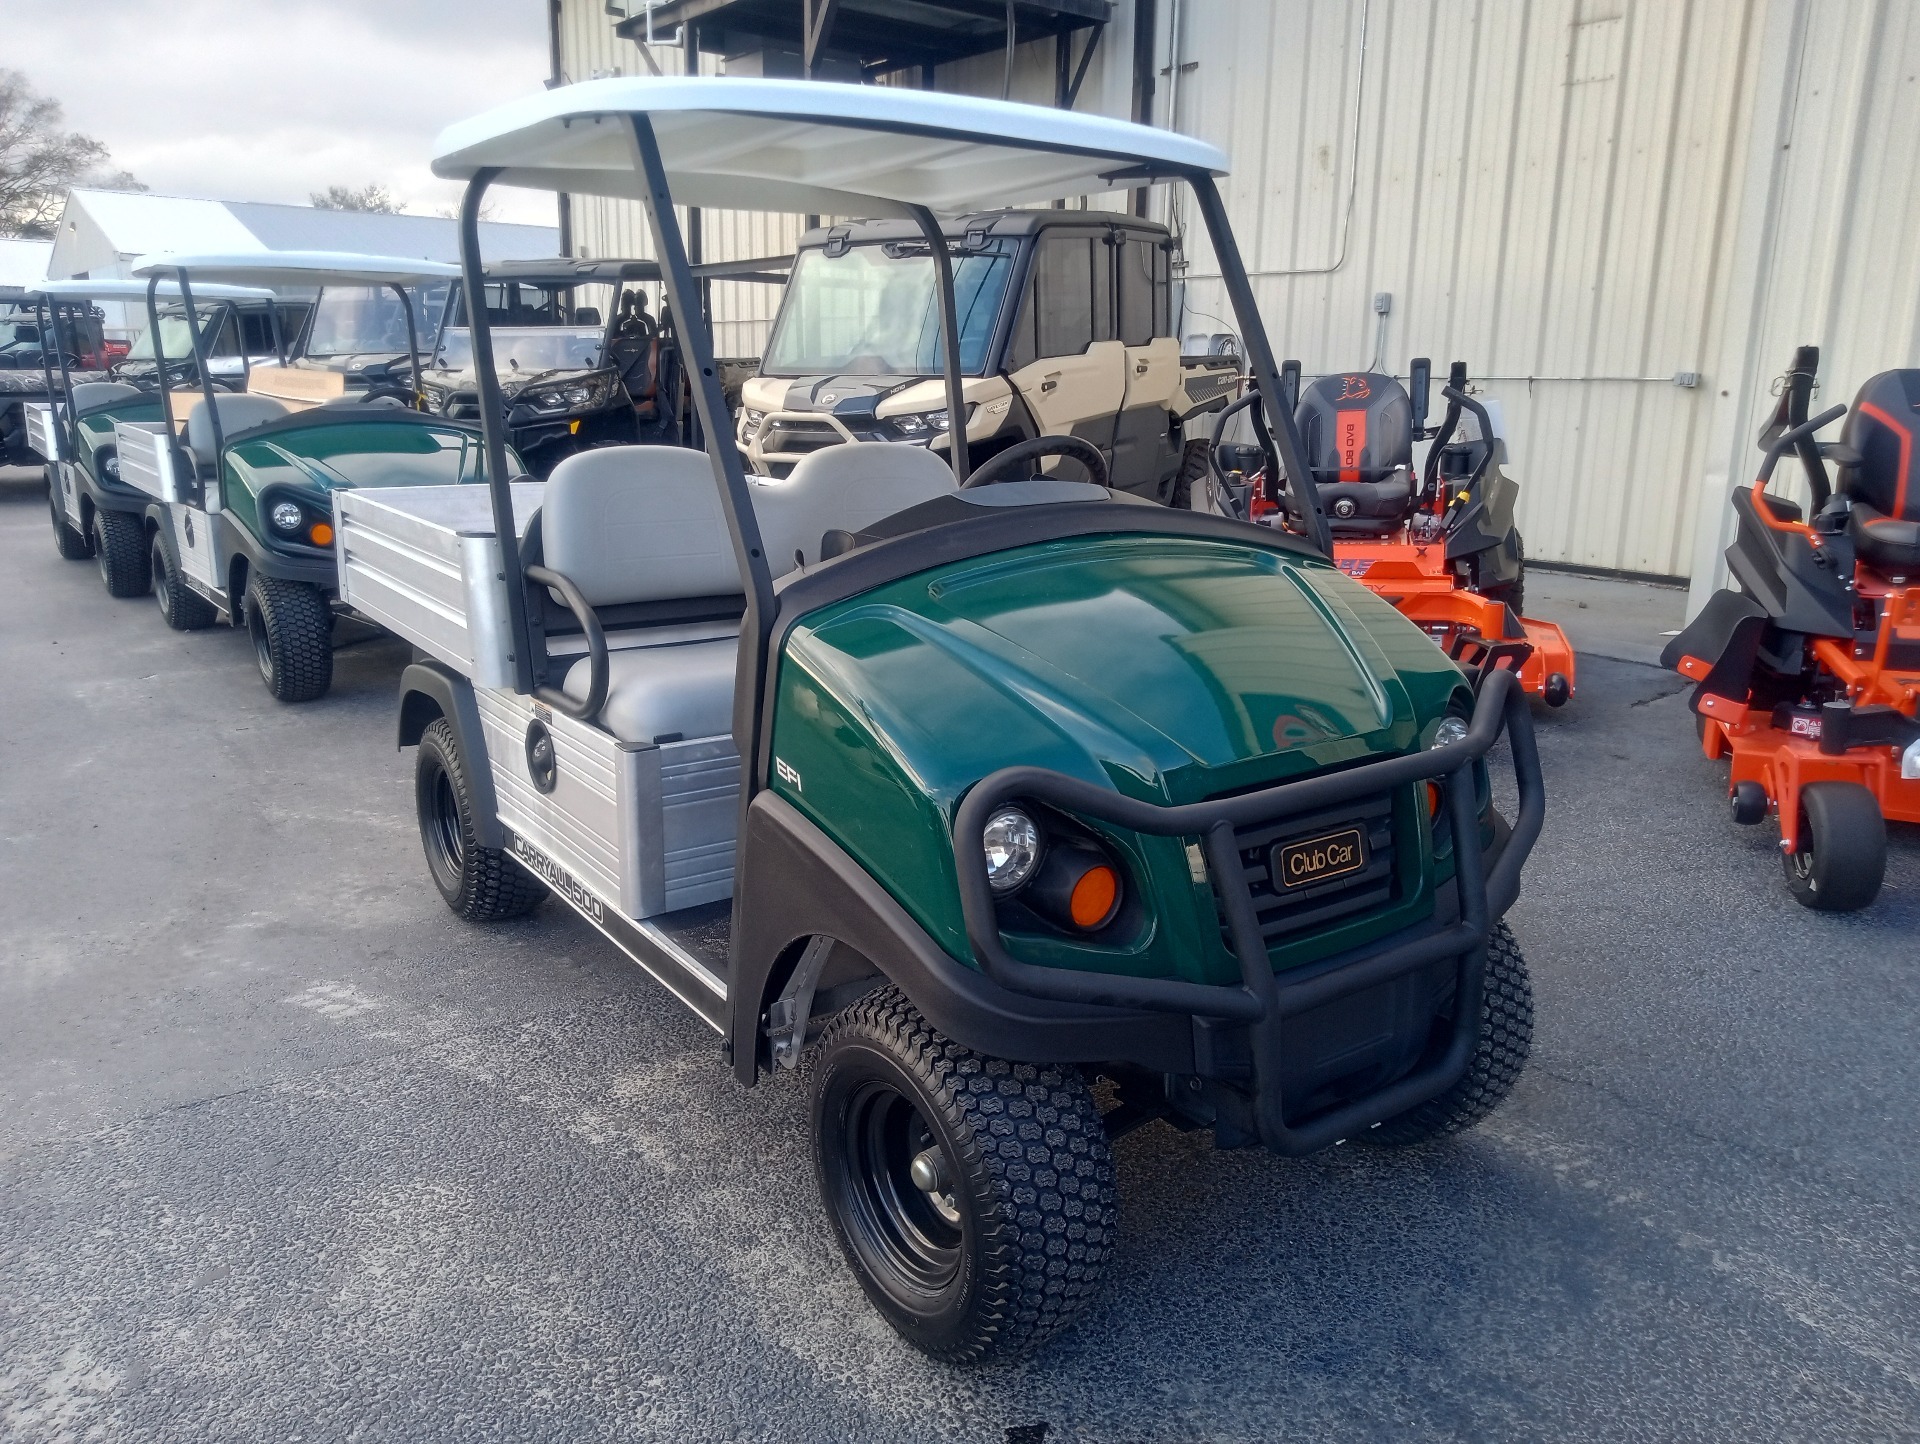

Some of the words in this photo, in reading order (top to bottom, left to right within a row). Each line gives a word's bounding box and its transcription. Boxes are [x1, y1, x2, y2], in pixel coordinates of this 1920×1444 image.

[1346, 423, 1355, 447] BAD
[775, 755, 803, 793] EFI
[1290, 848, 1326, 876] Club
[1326, 843, 1353, 866] Car
[514, 832, 573, 900] CARRYALL
[572, 879, 604, 925] 500
